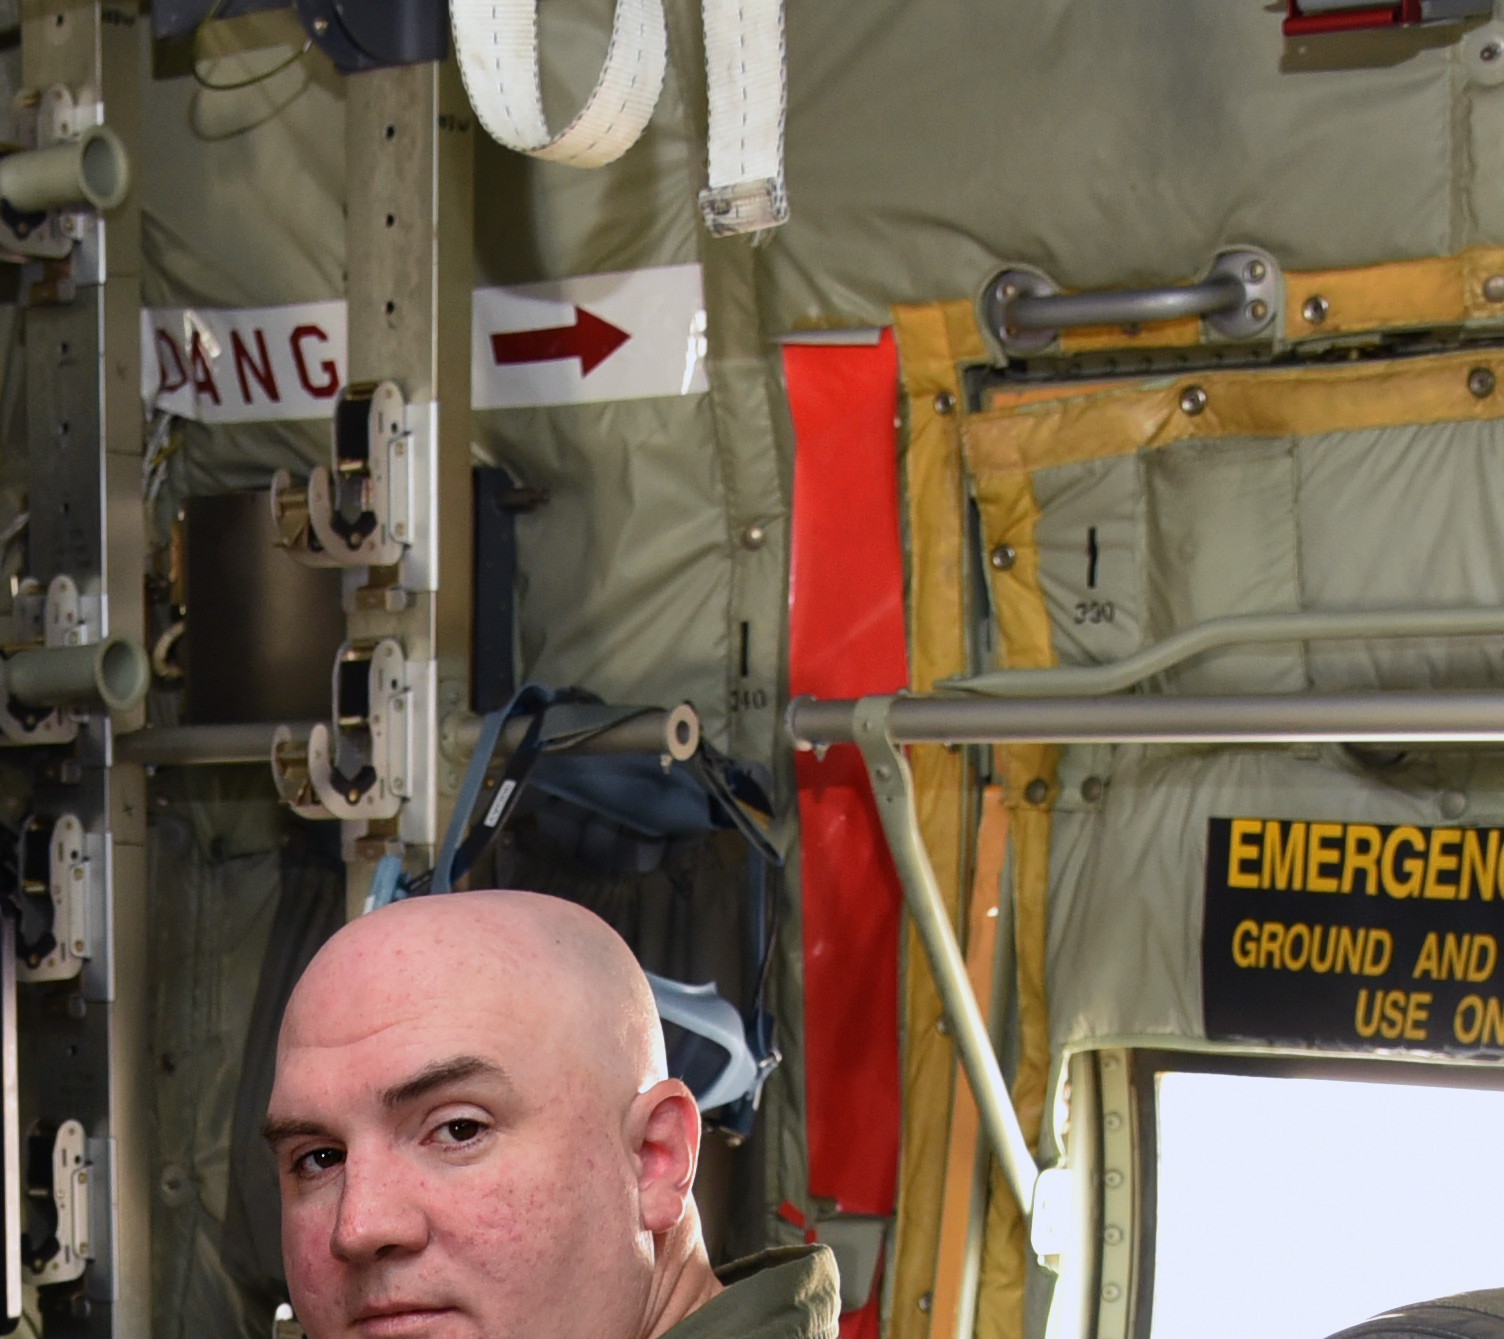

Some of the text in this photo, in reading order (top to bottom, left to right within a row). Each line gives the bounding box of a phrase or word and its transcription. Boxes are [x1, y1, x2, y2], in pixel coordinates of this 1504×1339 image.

[1232, 919, 1392, 976] GROUND
[1413, 932, 1497, 982] AND
[1354, 990, 1432, 1041] USE
